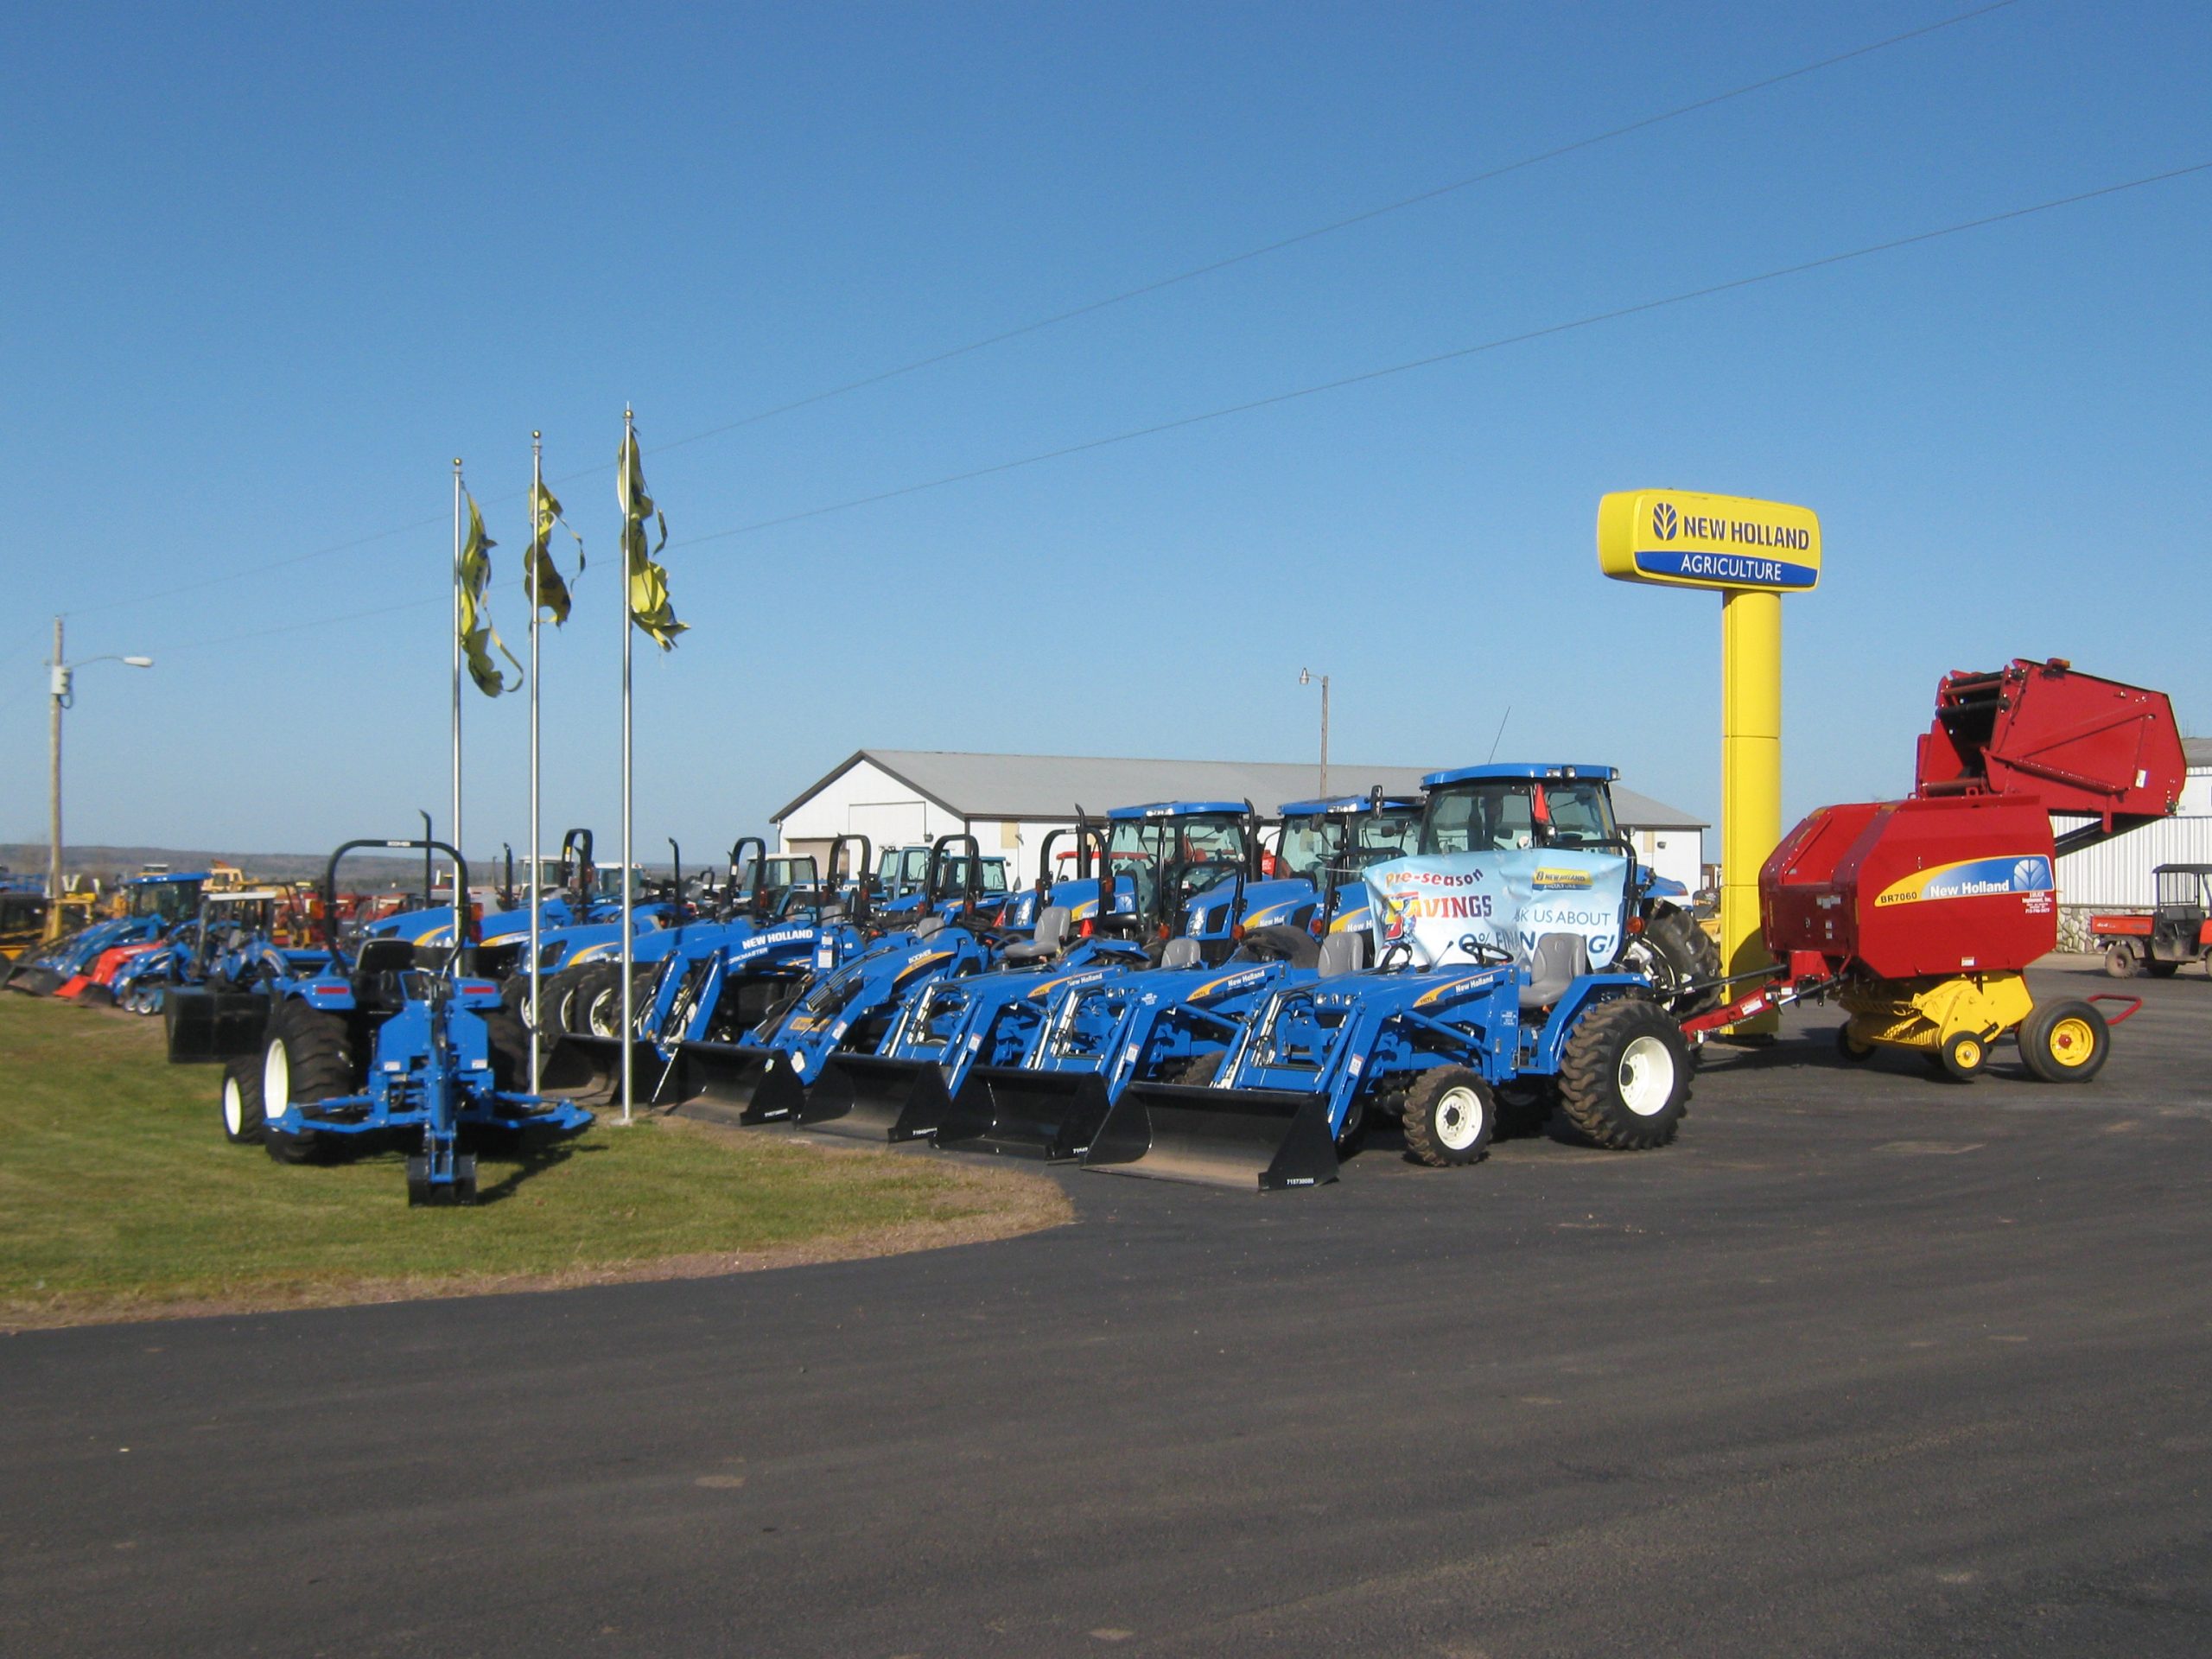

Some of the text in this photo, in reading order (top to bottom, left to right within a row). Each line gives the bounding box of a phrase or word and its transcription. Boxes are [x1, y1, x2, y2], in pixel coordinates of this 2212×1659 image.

[1683, 515, 1809, 550] NEW HOLLAND
[1680, 554, 1782, 582] AGRICULTURE
[1880, 892, 1917, 904] BR7060
[1930, 880, 2009, 899] New Holland
[1534, 909, 1553, 924] US
[1555, 911, 1611, 926] ABOUT
[742, 933, 766, 950] NEW
[767, 929, 813, 944] HOLLAND
[1081, 973, 1103, 984] Holland
[1228, 978, 1242, 988] New
[1242, 969, 1265, 983] Holland
[1455, 975, 1494, 993] New Holland
